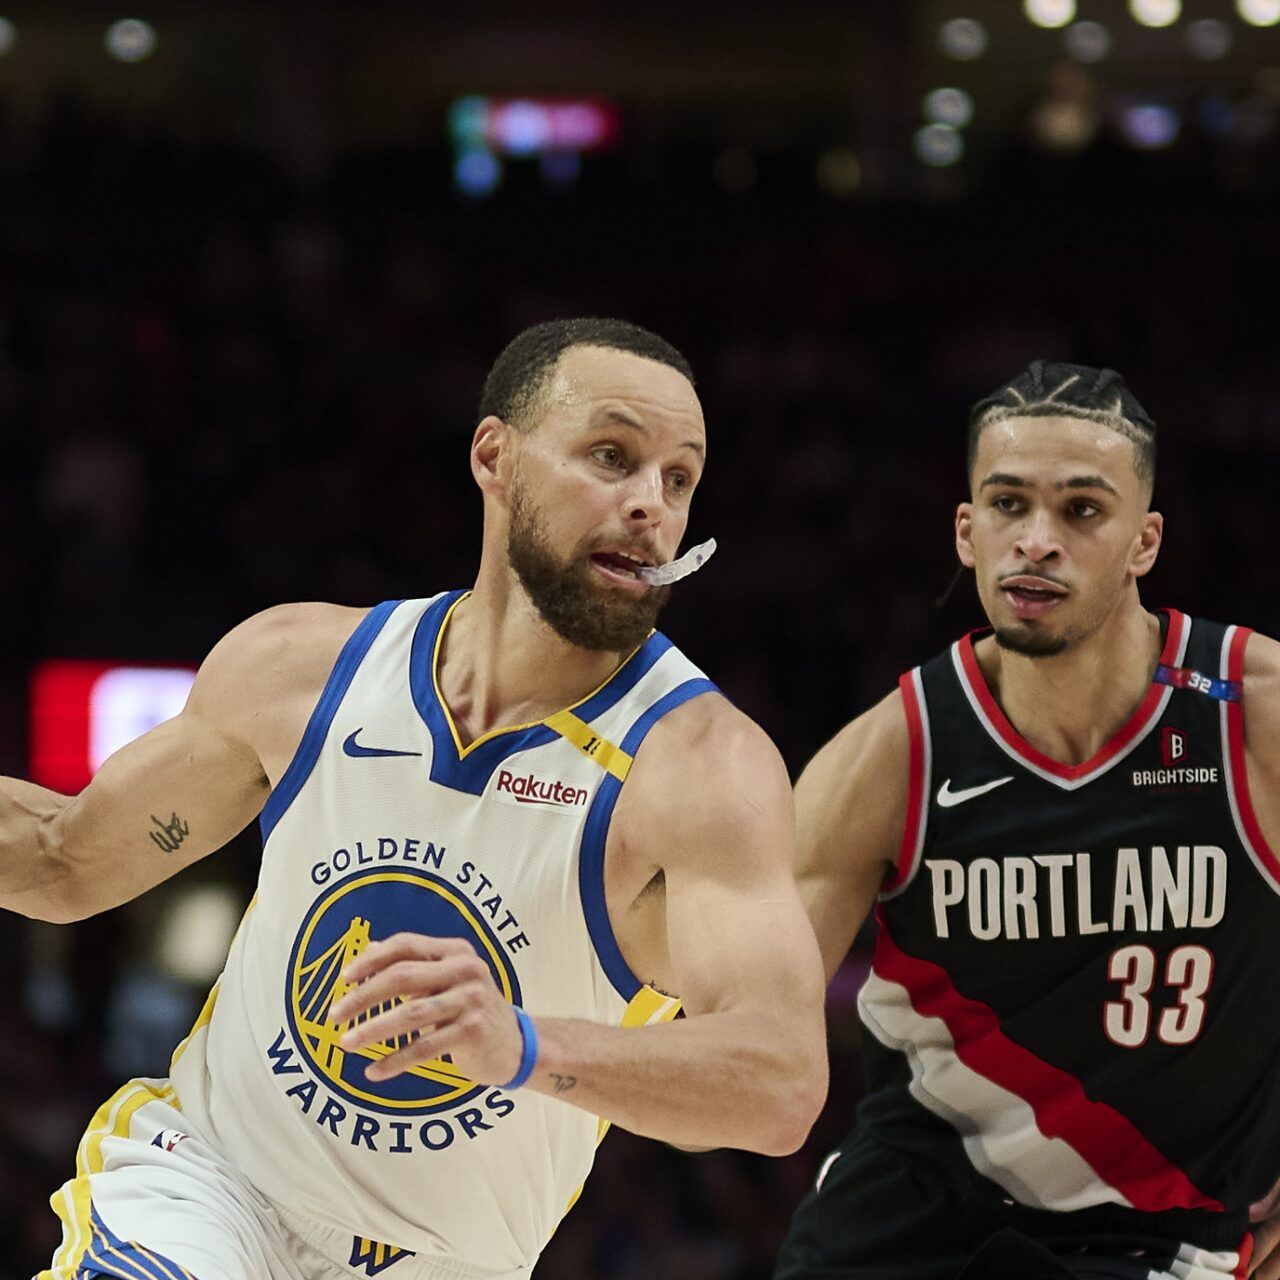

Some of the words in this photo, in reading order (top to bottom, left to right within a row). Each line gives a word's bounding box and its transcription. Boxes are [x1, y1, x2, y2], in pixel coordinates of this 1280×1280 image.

[1188, 672, 1212, 694] 32
[497, 770, 588, 806] Rakuten
[1132, 768, 1219, 786] BRIGHTSIDE
[311, 838, 446, 886] GOLDEN
[456, 861, 531, 954] STATE
[924, 845, 1228, 941] PORTLAND
[1103, 943, 1215, 1049] 33
[267, 1026, 515, 1154] WARRIORS
